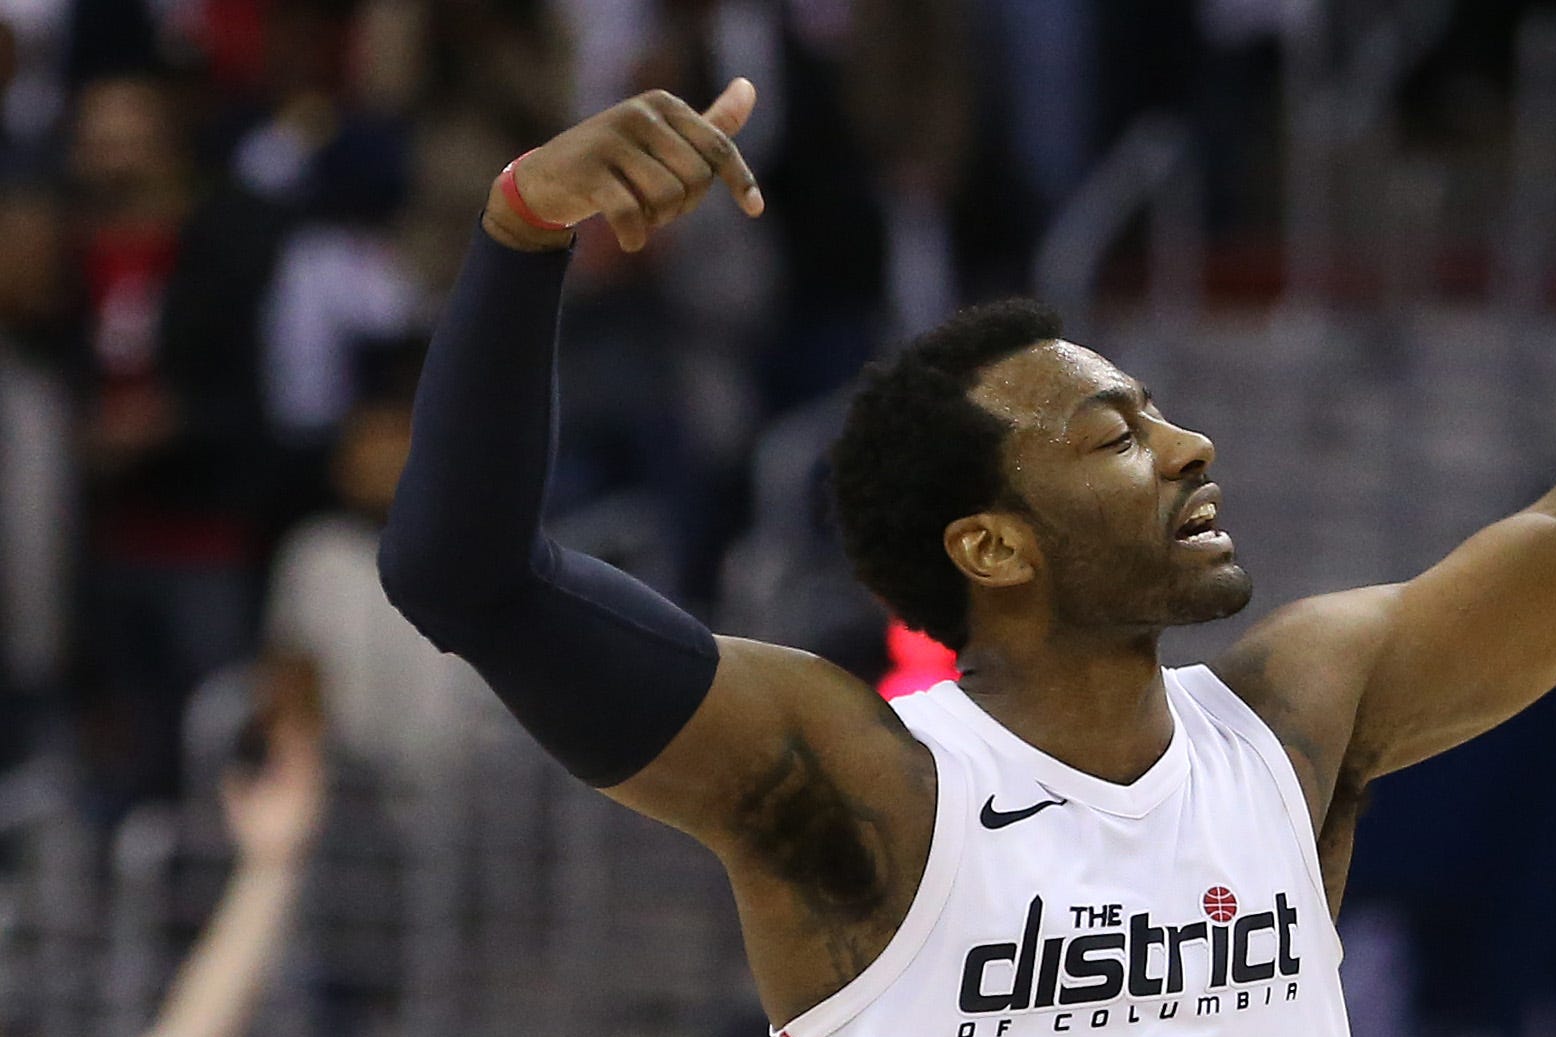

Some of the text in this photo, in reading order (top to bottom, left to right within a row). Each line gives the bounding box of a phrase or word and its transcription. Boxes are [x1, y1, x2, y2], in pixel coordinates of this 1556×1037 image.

[1070, 904, 1123, 928] THE
[959, 886, 1301, 1013] district
[1053, 982, 1298, 1032] COLUMBIA
